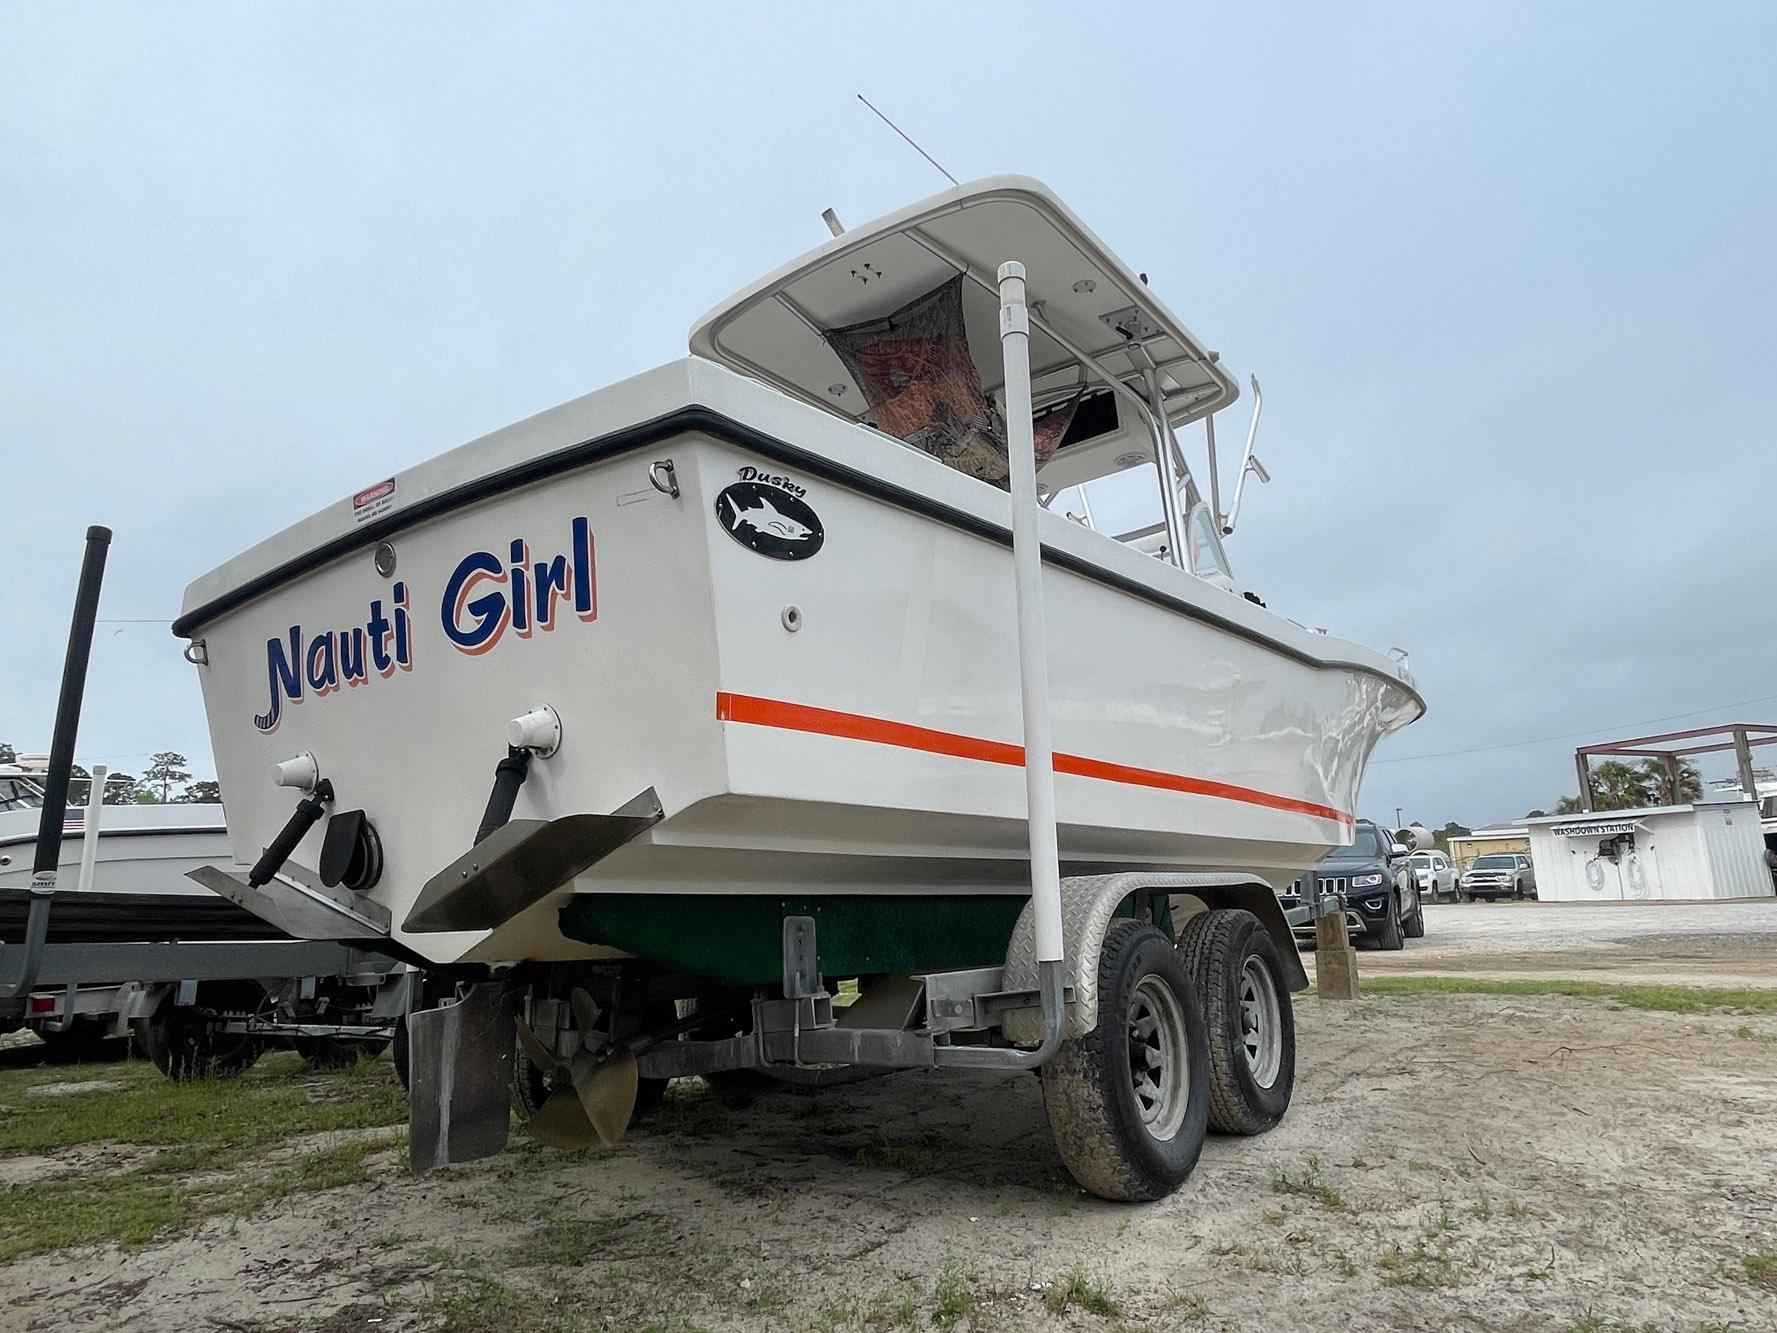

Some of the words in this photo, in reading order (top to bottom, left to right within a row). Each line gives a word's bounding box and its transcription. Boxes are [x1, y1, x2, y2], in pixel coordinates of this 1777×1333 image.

[738, 466, 807, 498] Dusky
[254, 580, 413, 735] Nauti
[441, 515, 599, 656] Girl
[1553, 825, 1599, 836] WASHDOWN
[1602, 823, 1634, 833] STATION
